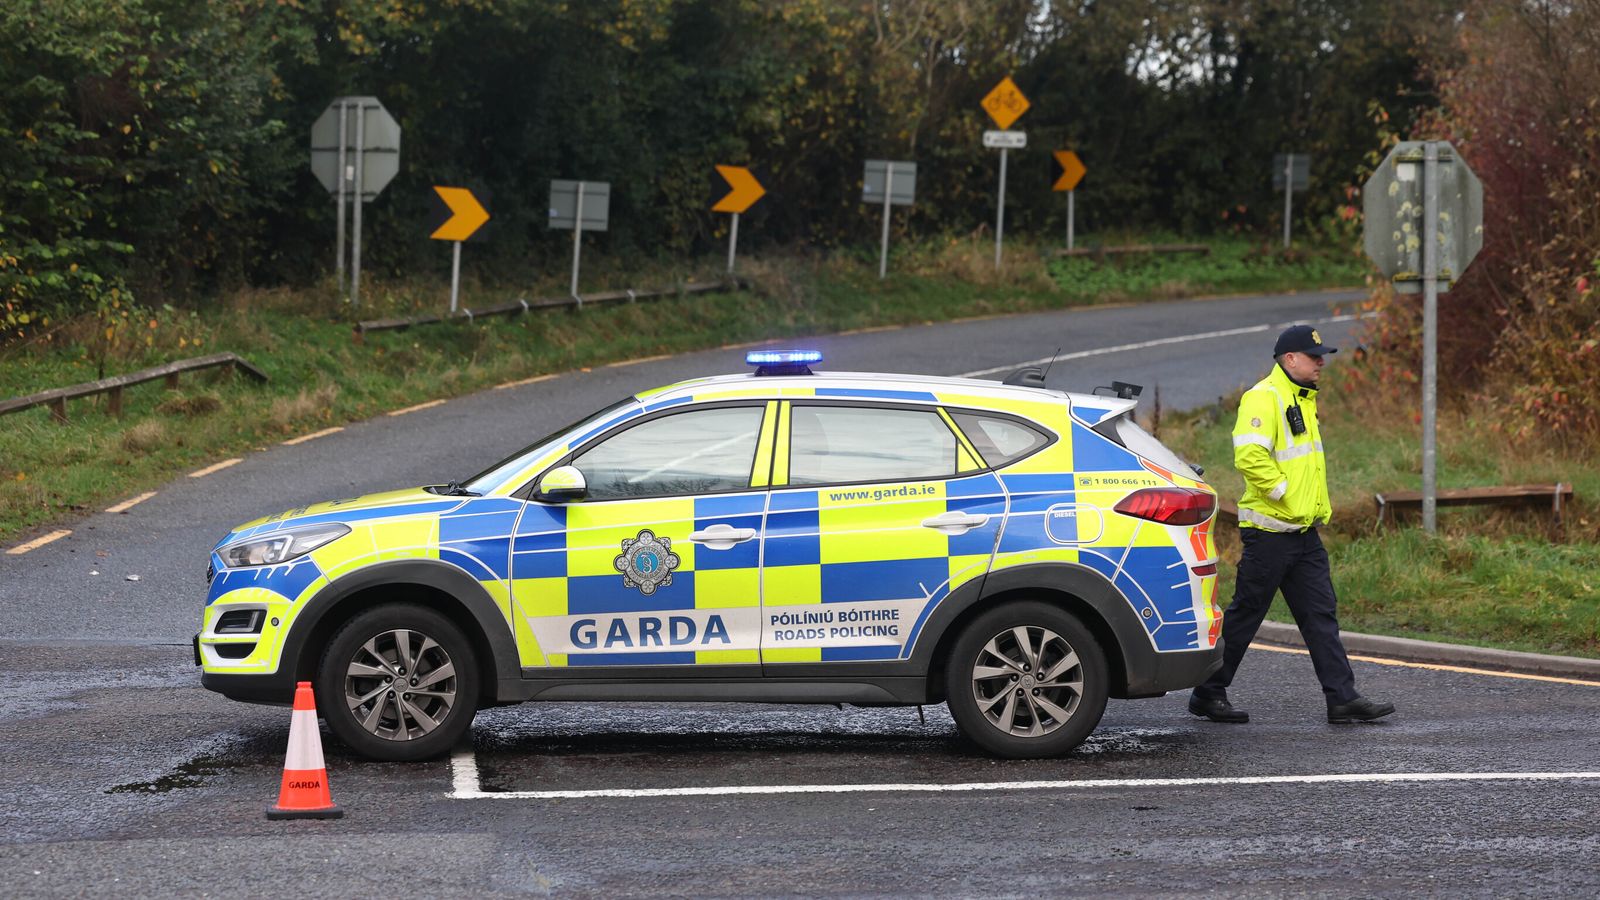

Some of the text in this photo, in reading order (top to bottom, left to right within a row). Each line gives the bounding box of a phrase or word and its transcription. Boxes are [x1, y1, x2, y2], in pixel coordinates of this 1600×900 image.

[829, 485, 936, 501] www.garda.ie
[770, 608, 900, 626] PÓILÍNIÚ BÓITHRE
[569, 614, 732, 650] GARDA
[774, 624, 899, 641] ROADS POLICING
[288, 781, 321, 789] GARDA
